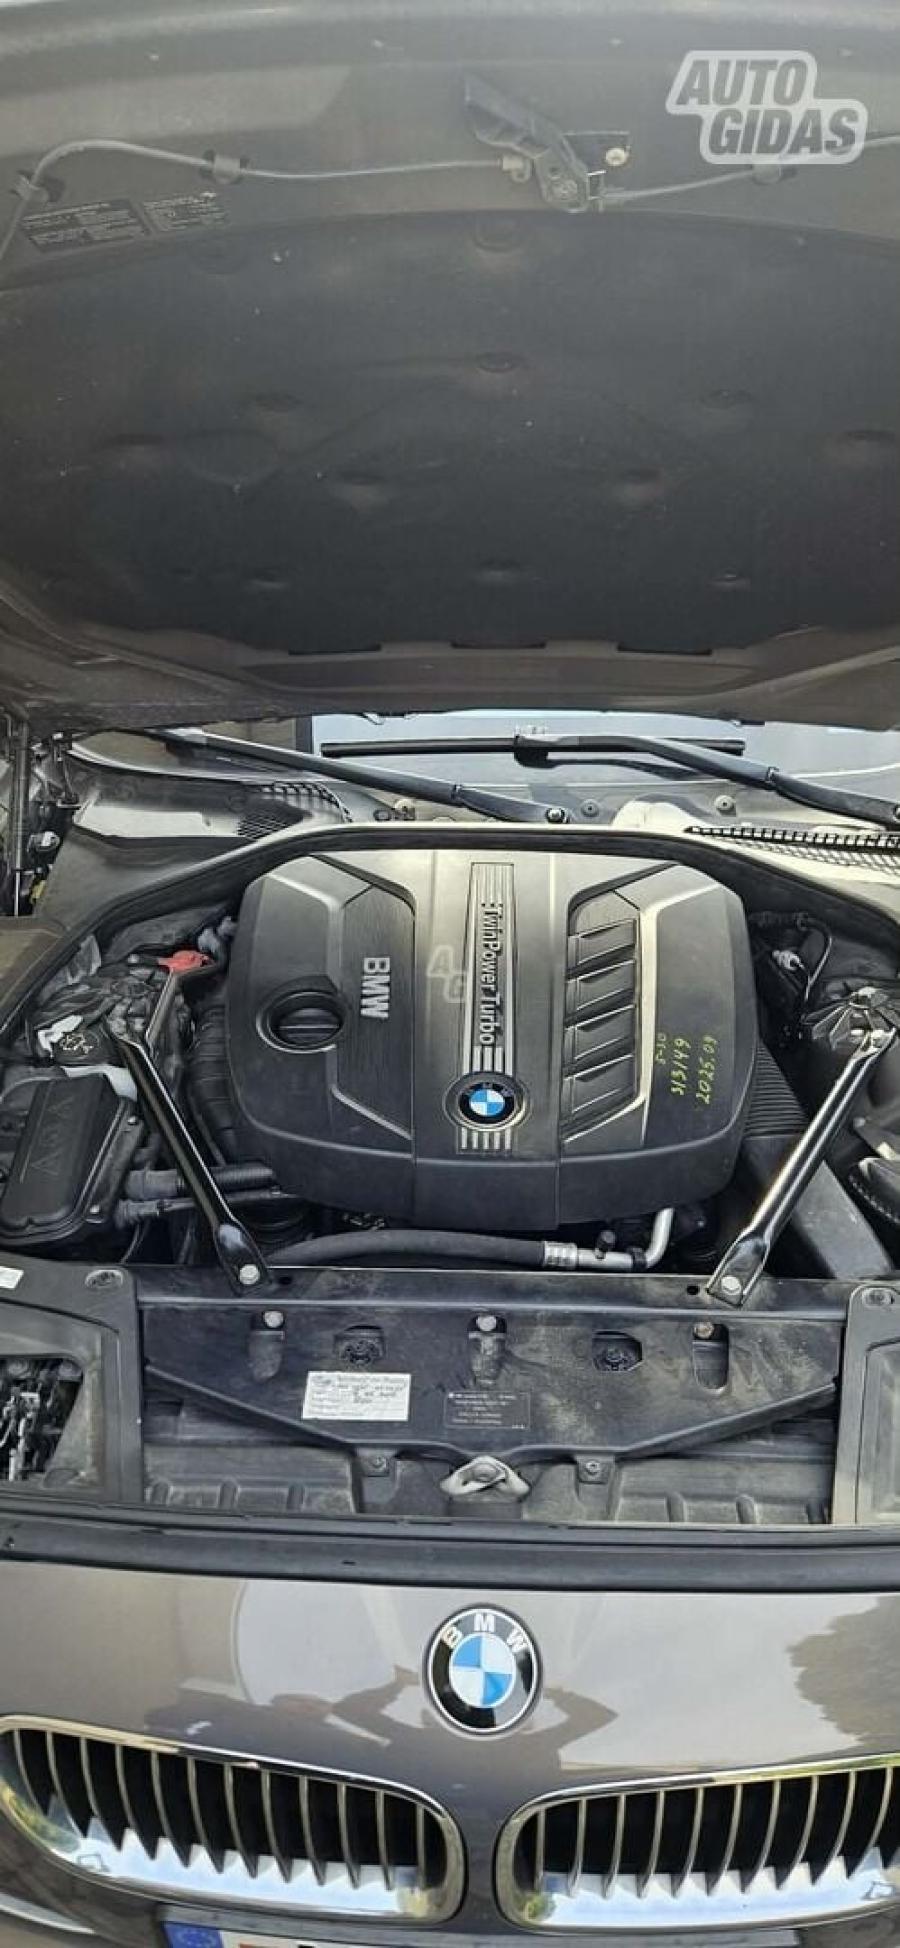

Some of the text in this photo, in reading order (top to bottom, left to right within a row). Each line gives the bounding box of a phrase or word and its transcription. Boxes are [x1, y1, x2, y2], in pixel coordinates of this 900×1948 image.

[361, 957, 391, 1019] BMW
[479, 907, 503, 1045] TwinPower Turbo
[440, 1611, 530, 1654] BMW
